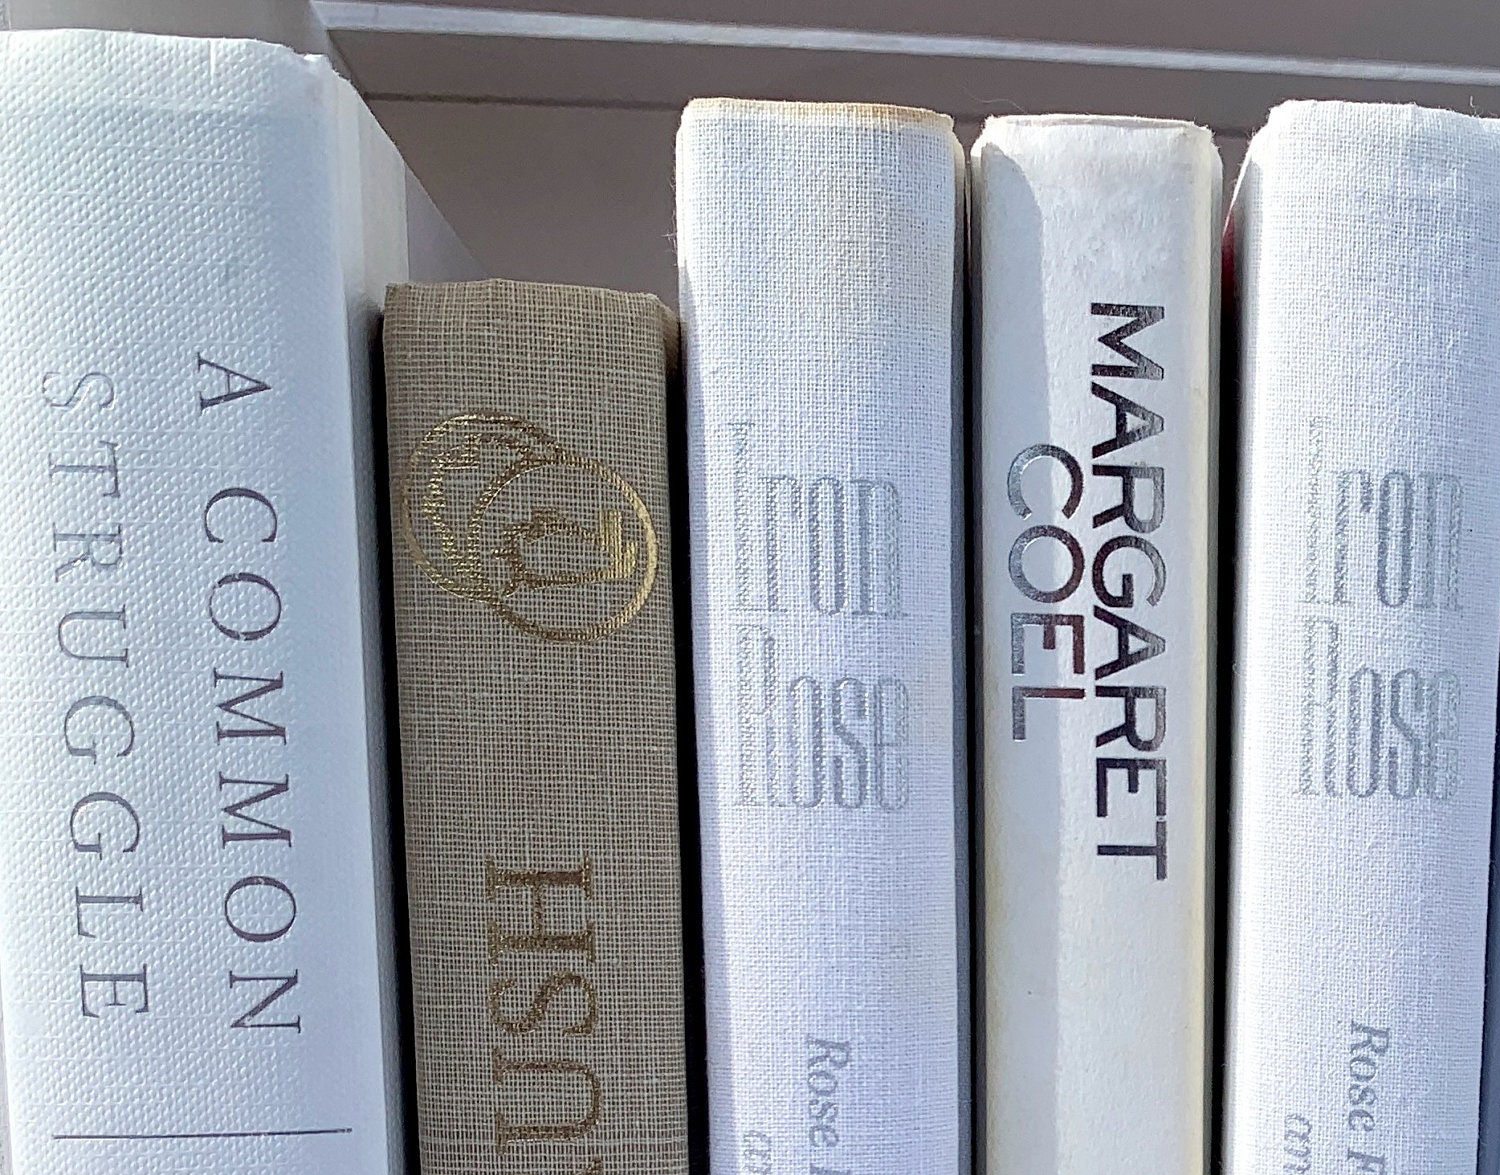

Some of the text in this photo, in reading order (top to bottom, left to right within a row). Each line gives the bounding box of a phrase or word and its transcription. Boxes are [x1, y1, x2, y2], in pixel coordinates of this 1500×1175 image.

[42, 371, 149, 1018] STRUGGLE
[199, 354, 301, 1034] A COMMON
[1007, 443, 1086, 741] COEL
[1091, 302, 1167, 881] MARGARET
[1292, 613, 1462, 800] Rose
[732, 624, 909, 809] Rose
[807, 1034, 850, 1147] Rose
[1349, 1020, 1391, 1133] Rose
